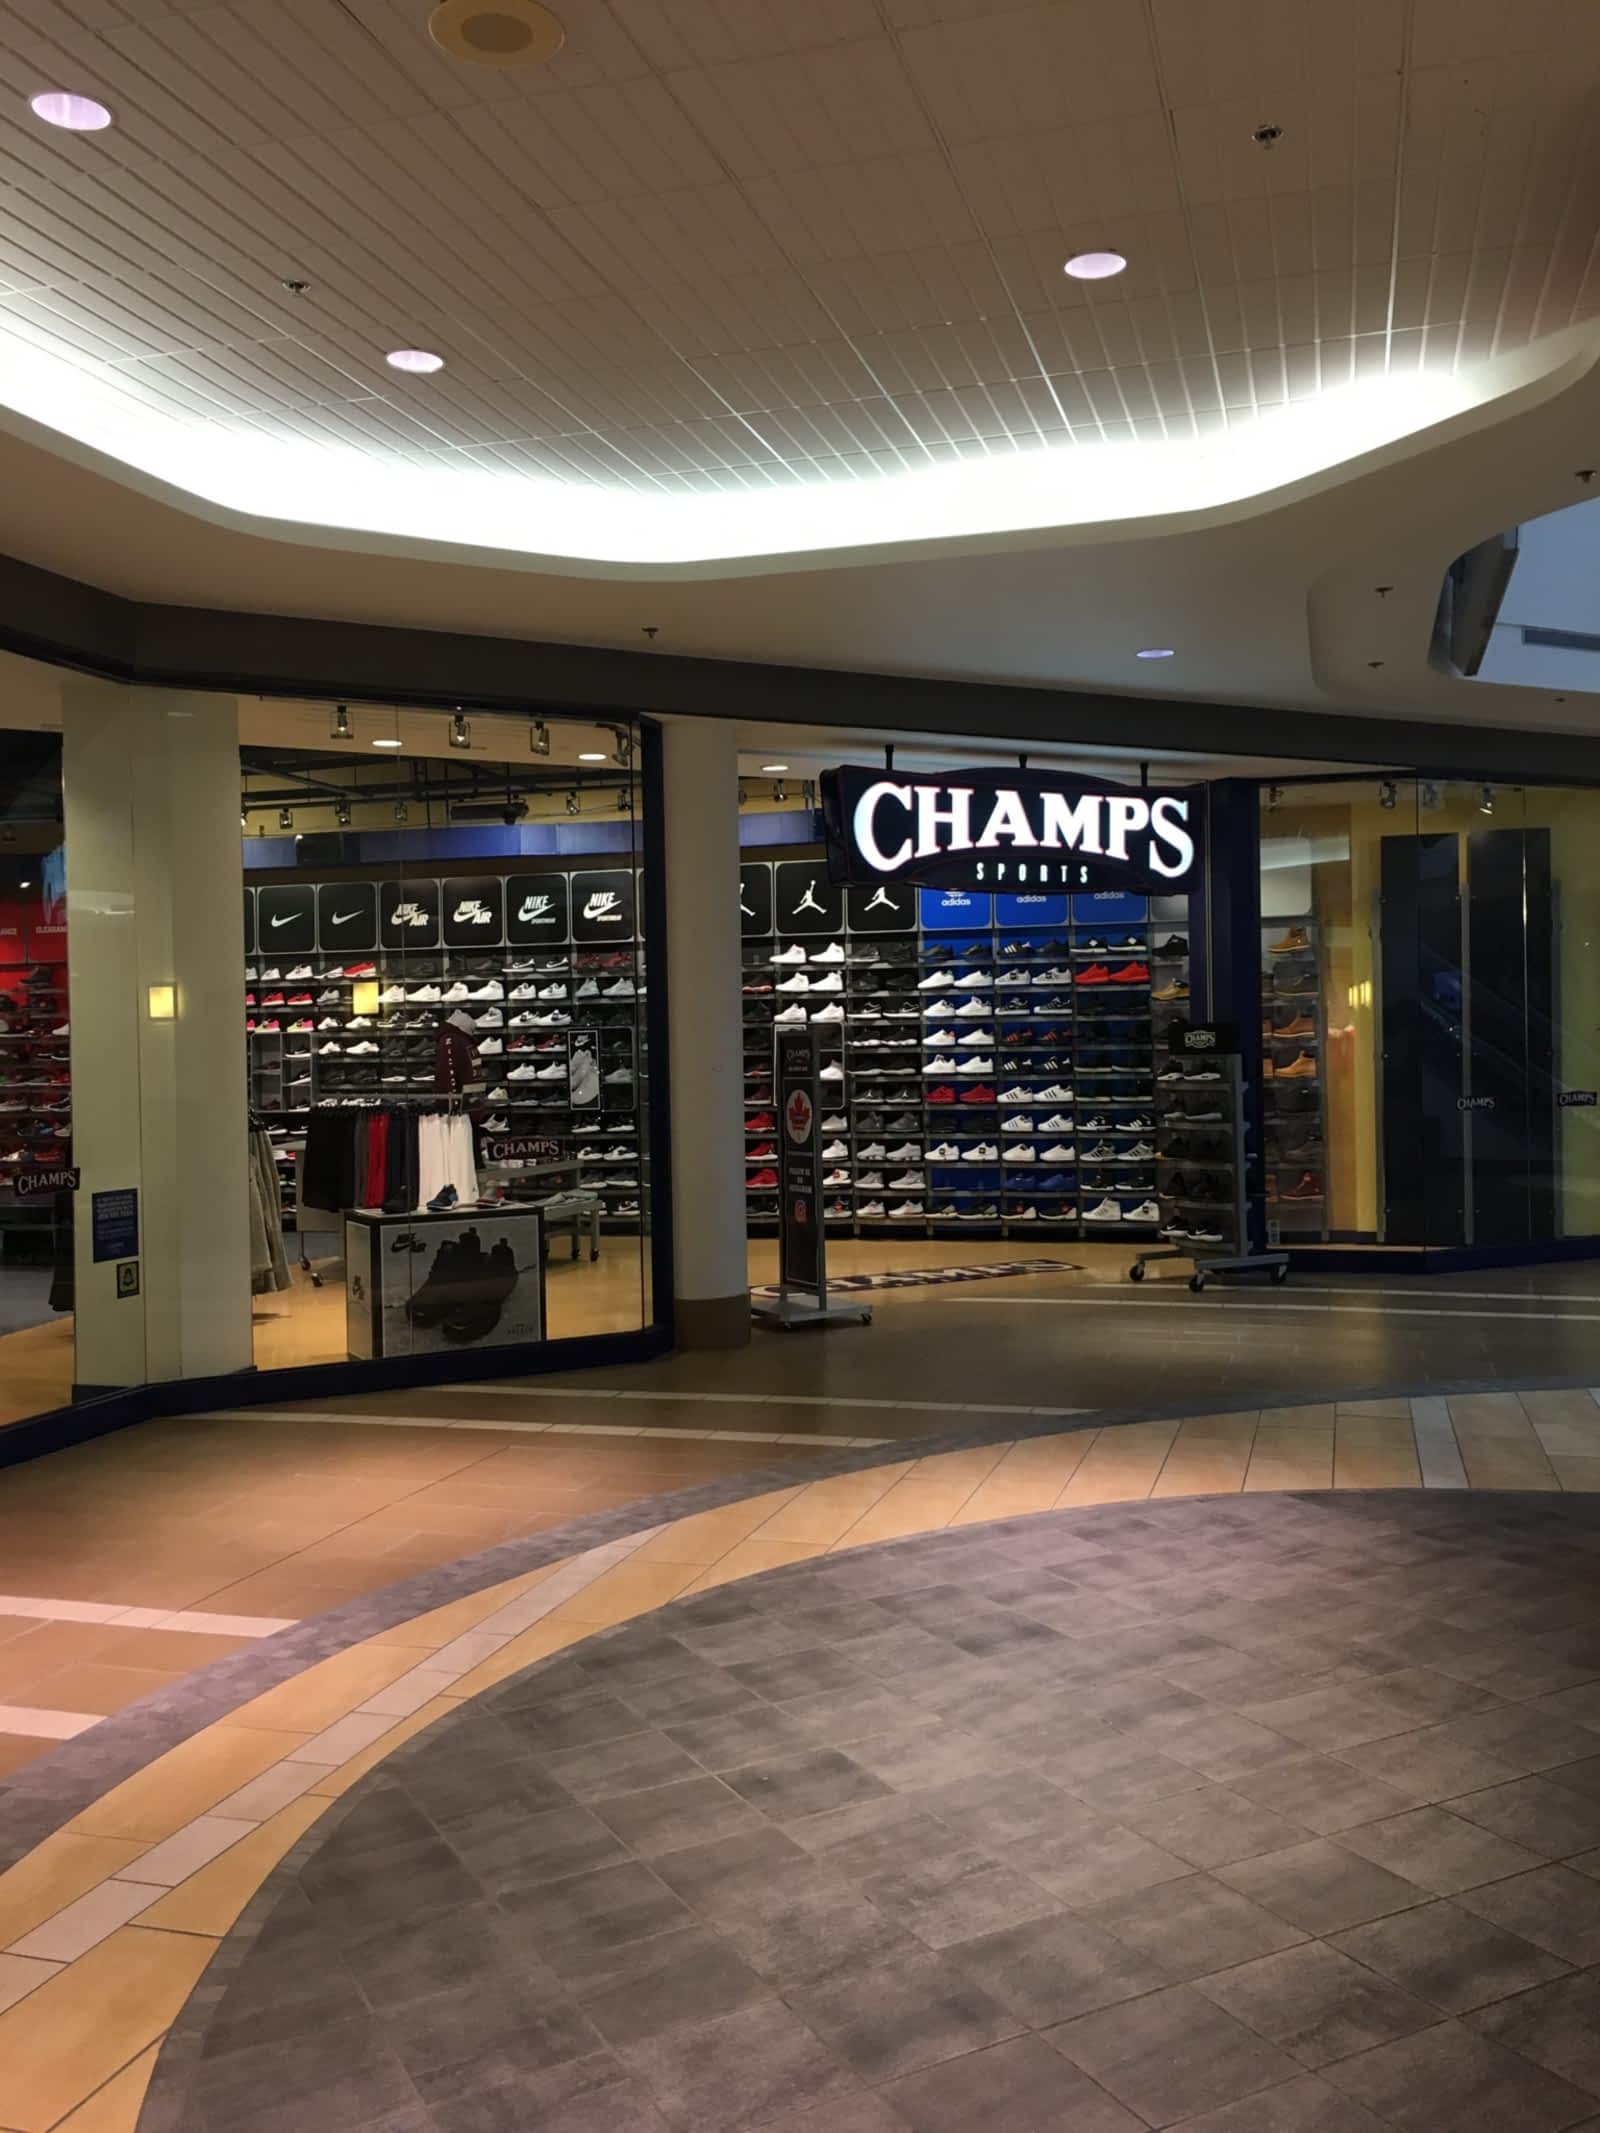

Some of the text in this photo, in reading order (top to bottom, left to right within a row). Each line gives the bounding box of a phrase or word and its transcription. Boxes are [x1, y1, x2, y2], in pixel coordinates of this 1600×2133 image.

[853, 781, 1195, 879] CHAMPS
[976, 862, 1088, 883] SPORTS
[524, 895, 549, 910] NIKE
[590, 892, 615, 907] NIKE
[941, 897, 971, 907] adidas
[1016, 894, 1047, 903] adidas
[1094, 891, 1124, 900] adidas
[409, 913, 429, 926] AIR
[472, 911, 492, 924] AIR
[493, 1140, 560, 1159] CHAMPS
[17, 1169, 77, 1195] CHAMPS
